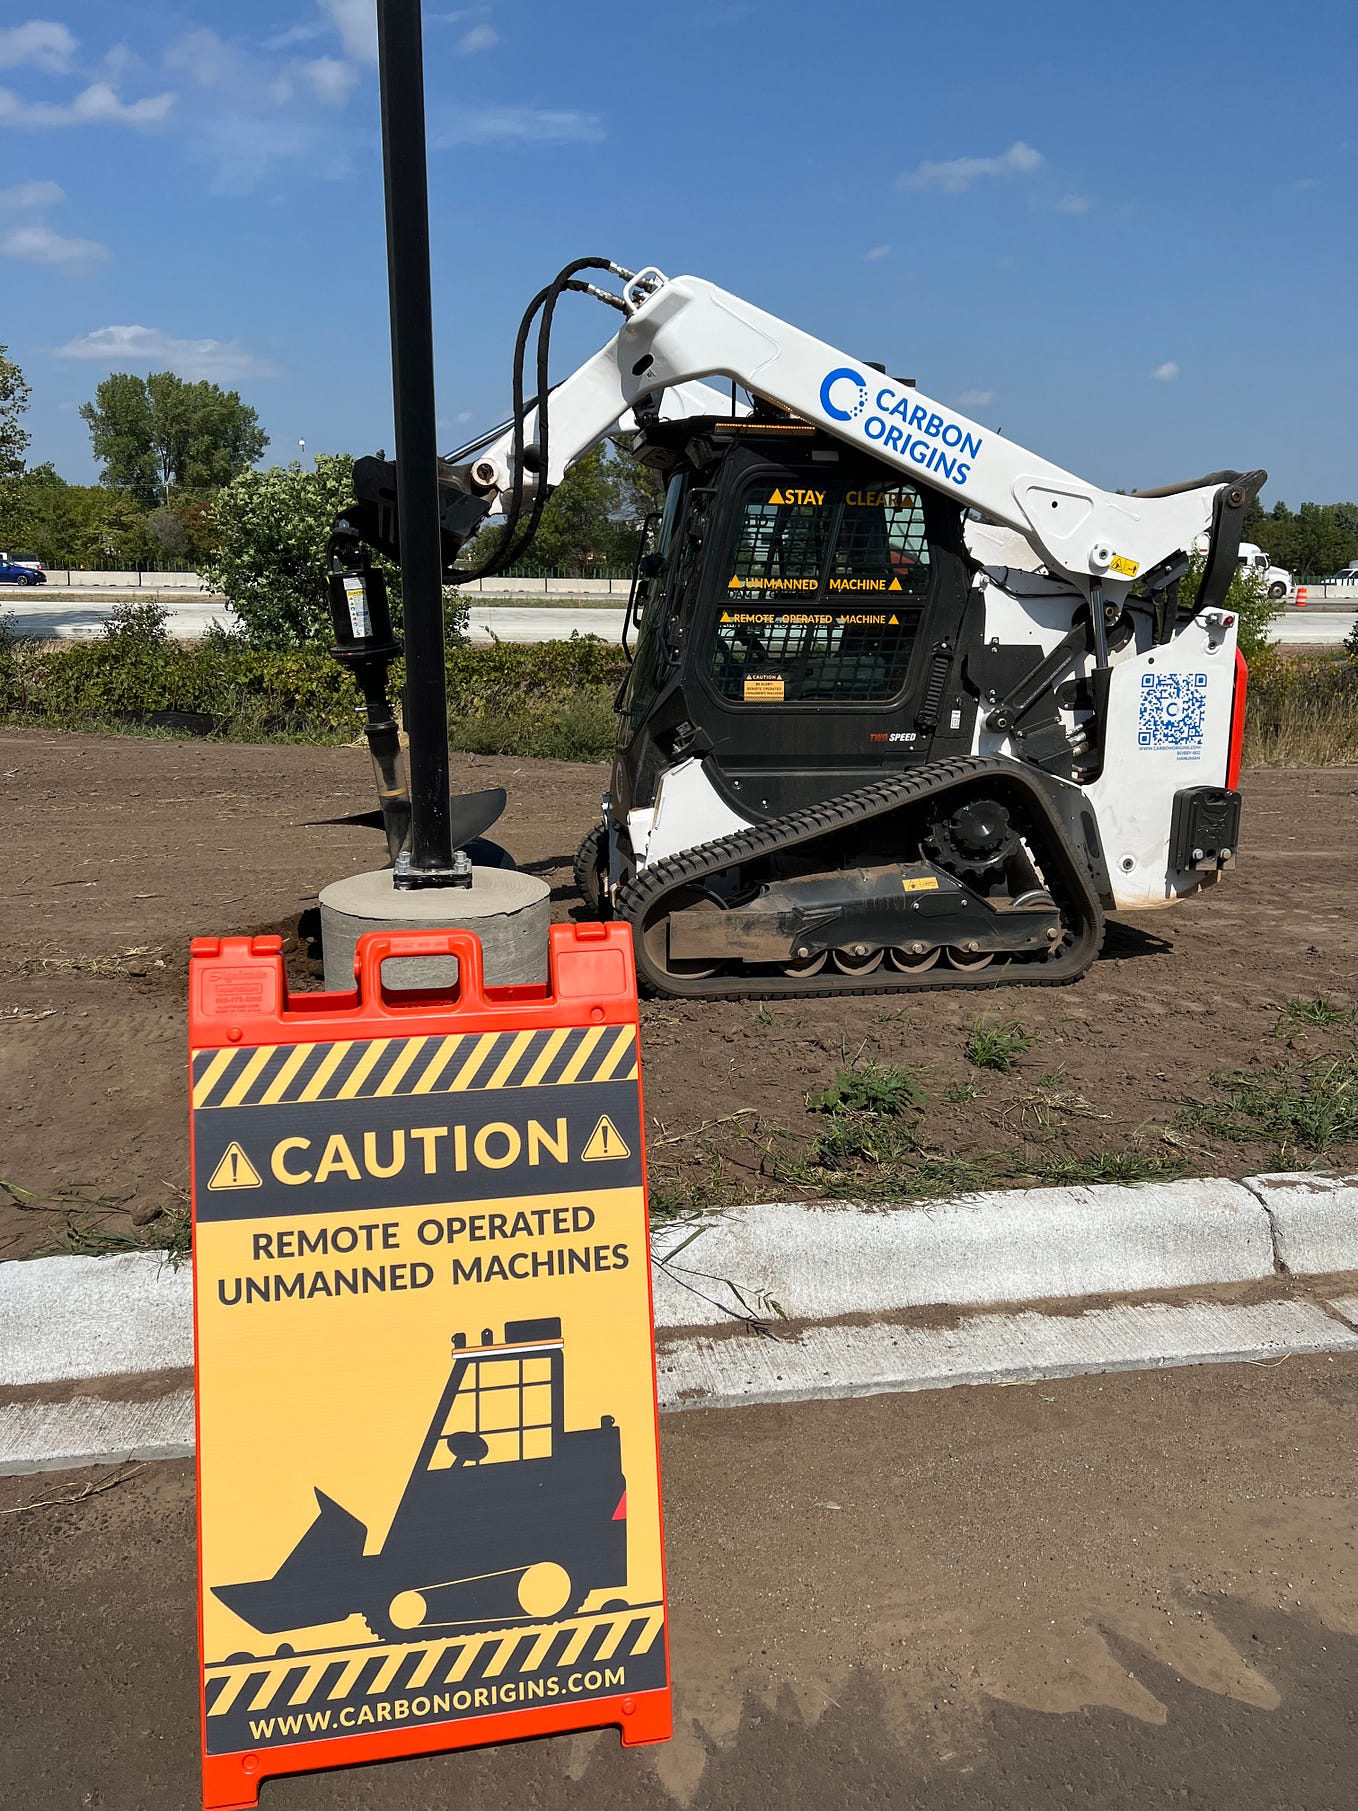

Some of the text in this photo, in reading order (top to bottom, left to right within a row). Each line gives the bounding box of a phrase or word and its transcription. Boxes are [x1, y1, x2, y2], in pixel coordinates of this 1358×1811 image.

[864, 416, 971, 485] ORIGINS
[876, 388, 983, 460] CARBON
[784, 489, 899, 507] STAY CLEAR
[744, 577, 886, 591] UNMANNED MACHINE
[733, 613, 886, 625] REMOTE OPERATED MACHINE
[869, 733, 917, 742] TWO SPEED
[270, 1117, 570, 1186] CAUTION
[252, 1206, 596, 1261] REMOTE OPERATED
[217, 1243, 630, 1306] UNMANNED MACHINES
[248, 1665, 627, 1741] WWW.CARBONORIGINS.COM
